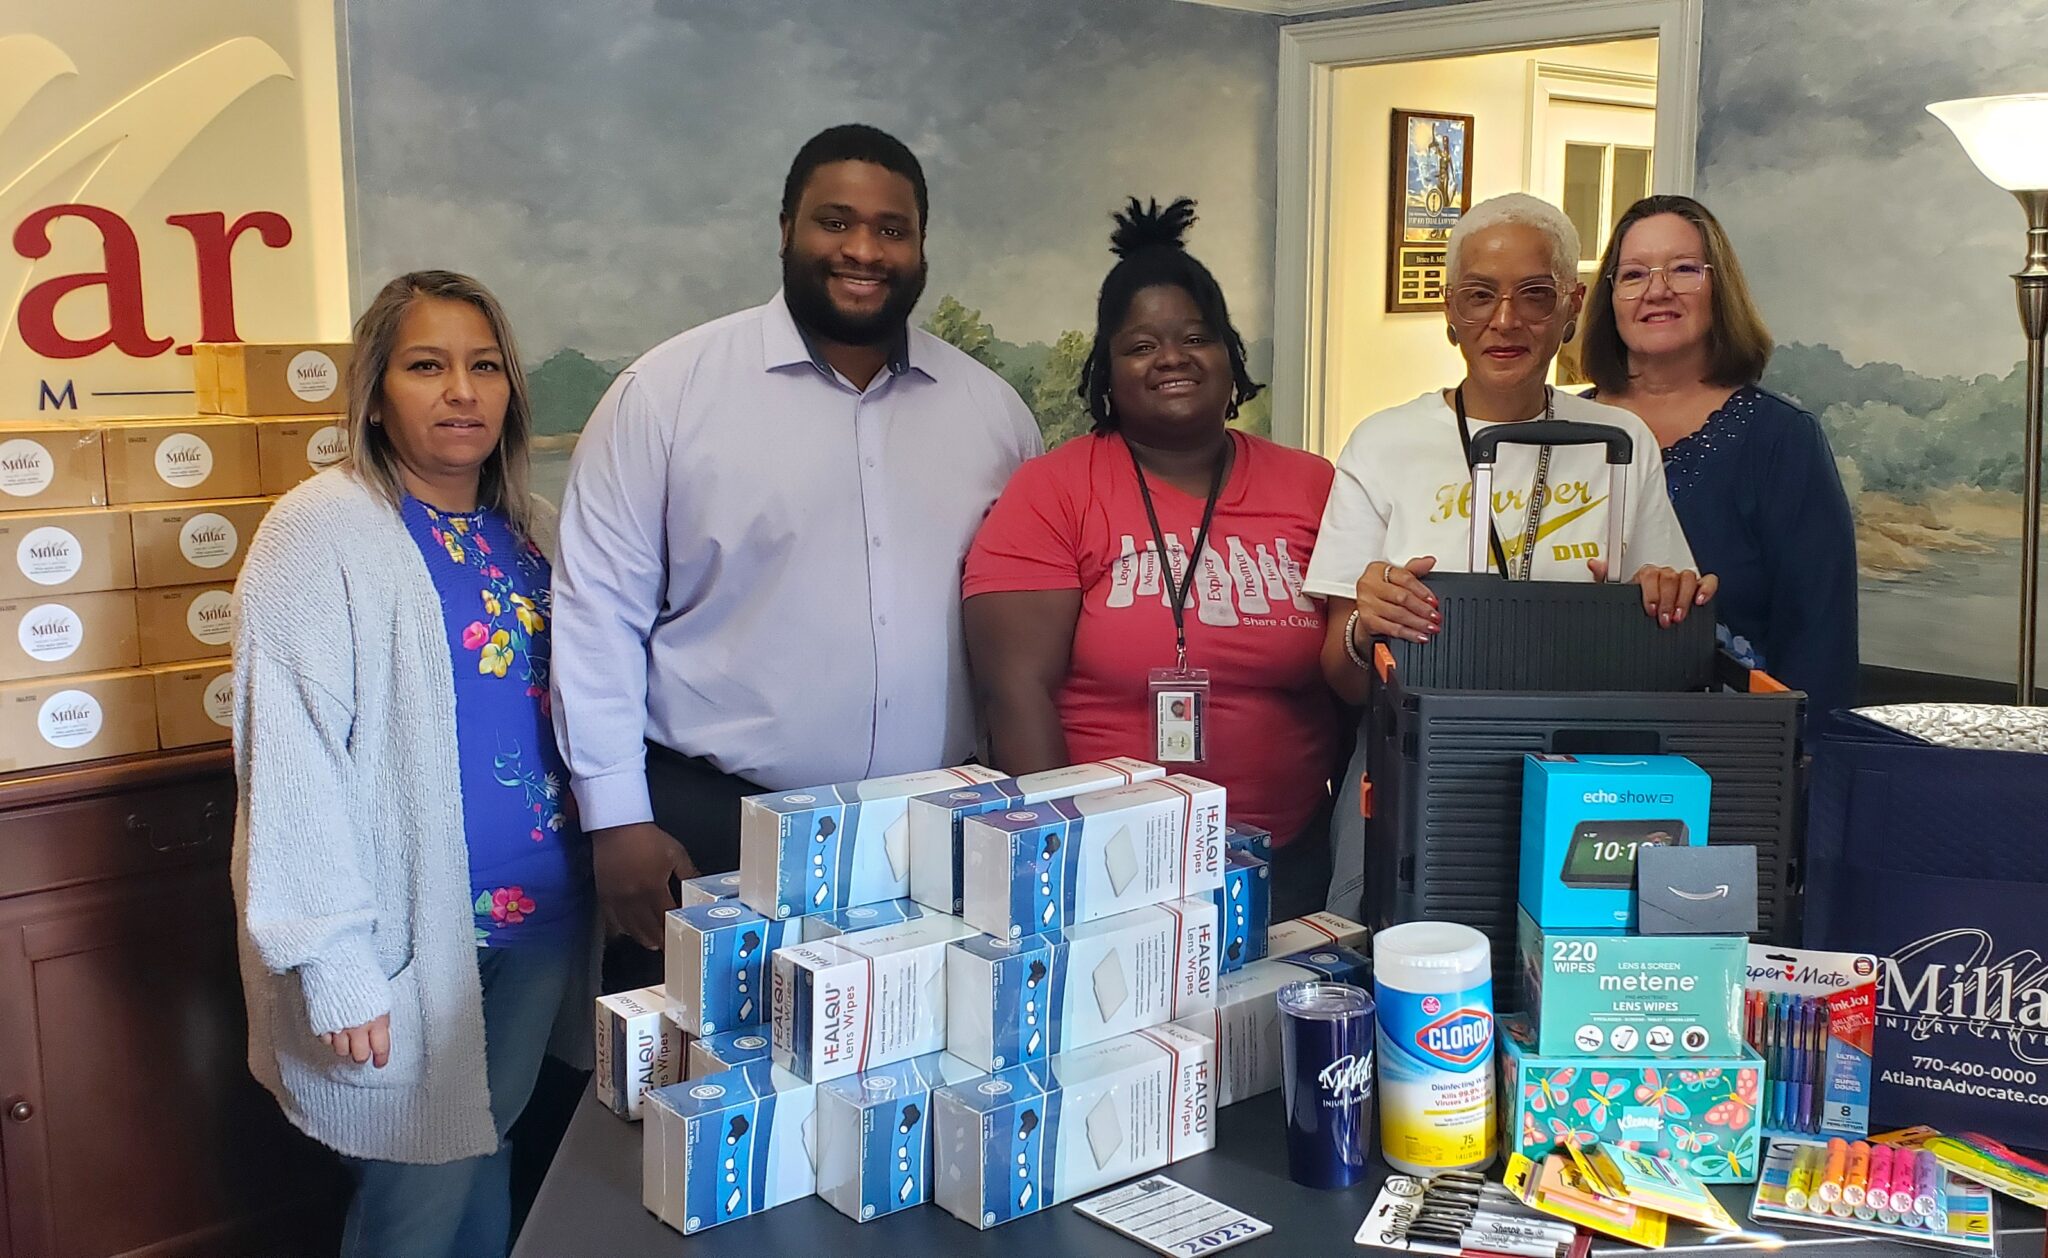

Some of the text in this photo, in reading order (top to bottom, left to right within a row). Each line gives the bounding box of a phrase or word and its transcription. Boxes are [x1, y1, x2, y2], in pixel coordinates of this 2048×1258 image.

[297, 367, 328, 380] Millar
[38, 379, 78, 411] M
[2, 458, 41, 471] Millar
[166, 451, 201, 464] Millar
[1430, 481, 1592, 523] Hrper
[191, 531, 226, 544] Millar
[30, 546, 69, 559] Millar
[1552, 542, 1599, 561] DID
[1117, 556, 1132, 587] Legen
[1234, 552, 1257, 598] Dreamer
[32, 623, 70, 636] Millar
[1243, 617, 1277, 627] Share
[1288, 614, 1321, 629] Coke
[51, 709, 90, 723] Millar
[1583, 789, 1658, 804] echo show
[1192, 807, 1206, 874] Lens Wipes
[1593, 841, 1654, 861] 10:1
[1552, 941, 1598, 962] 220
[1184, 926, 1197, 997] Lens Wipes
[1553, 962, 1597, 974] WIPES
[1618, 962, 1681, 970] LENS & SCREEN
[1600, 970, 1695, 992] metene
[1745, 965, 1787, 982] aper
[1794, 966, 1850, 987] Mate
[1612, 1001, 1679, 1012] LENS WIPES
[1830, 994, 1870, 1012] InkJoy
[842, 985, 858, 1060] Lens Wipes
[1875, 1016, 1959, 1035] INJURY
[1428, 1014, 1489, 1051] CLOROX
[657, 1032, 672, 1074] Wipes
[638, 1033, 654, 1105] EALQU
[1912, 1055, 2037, 1085] 770-400-0000
[1181, 1064, 1193, 1137] Lens Wipes
[1840, 1105, 1852, 1117] 8
[1463, 1134, 1474, 1145] 75
[1180, 1222, 1257, 1255] 2023
